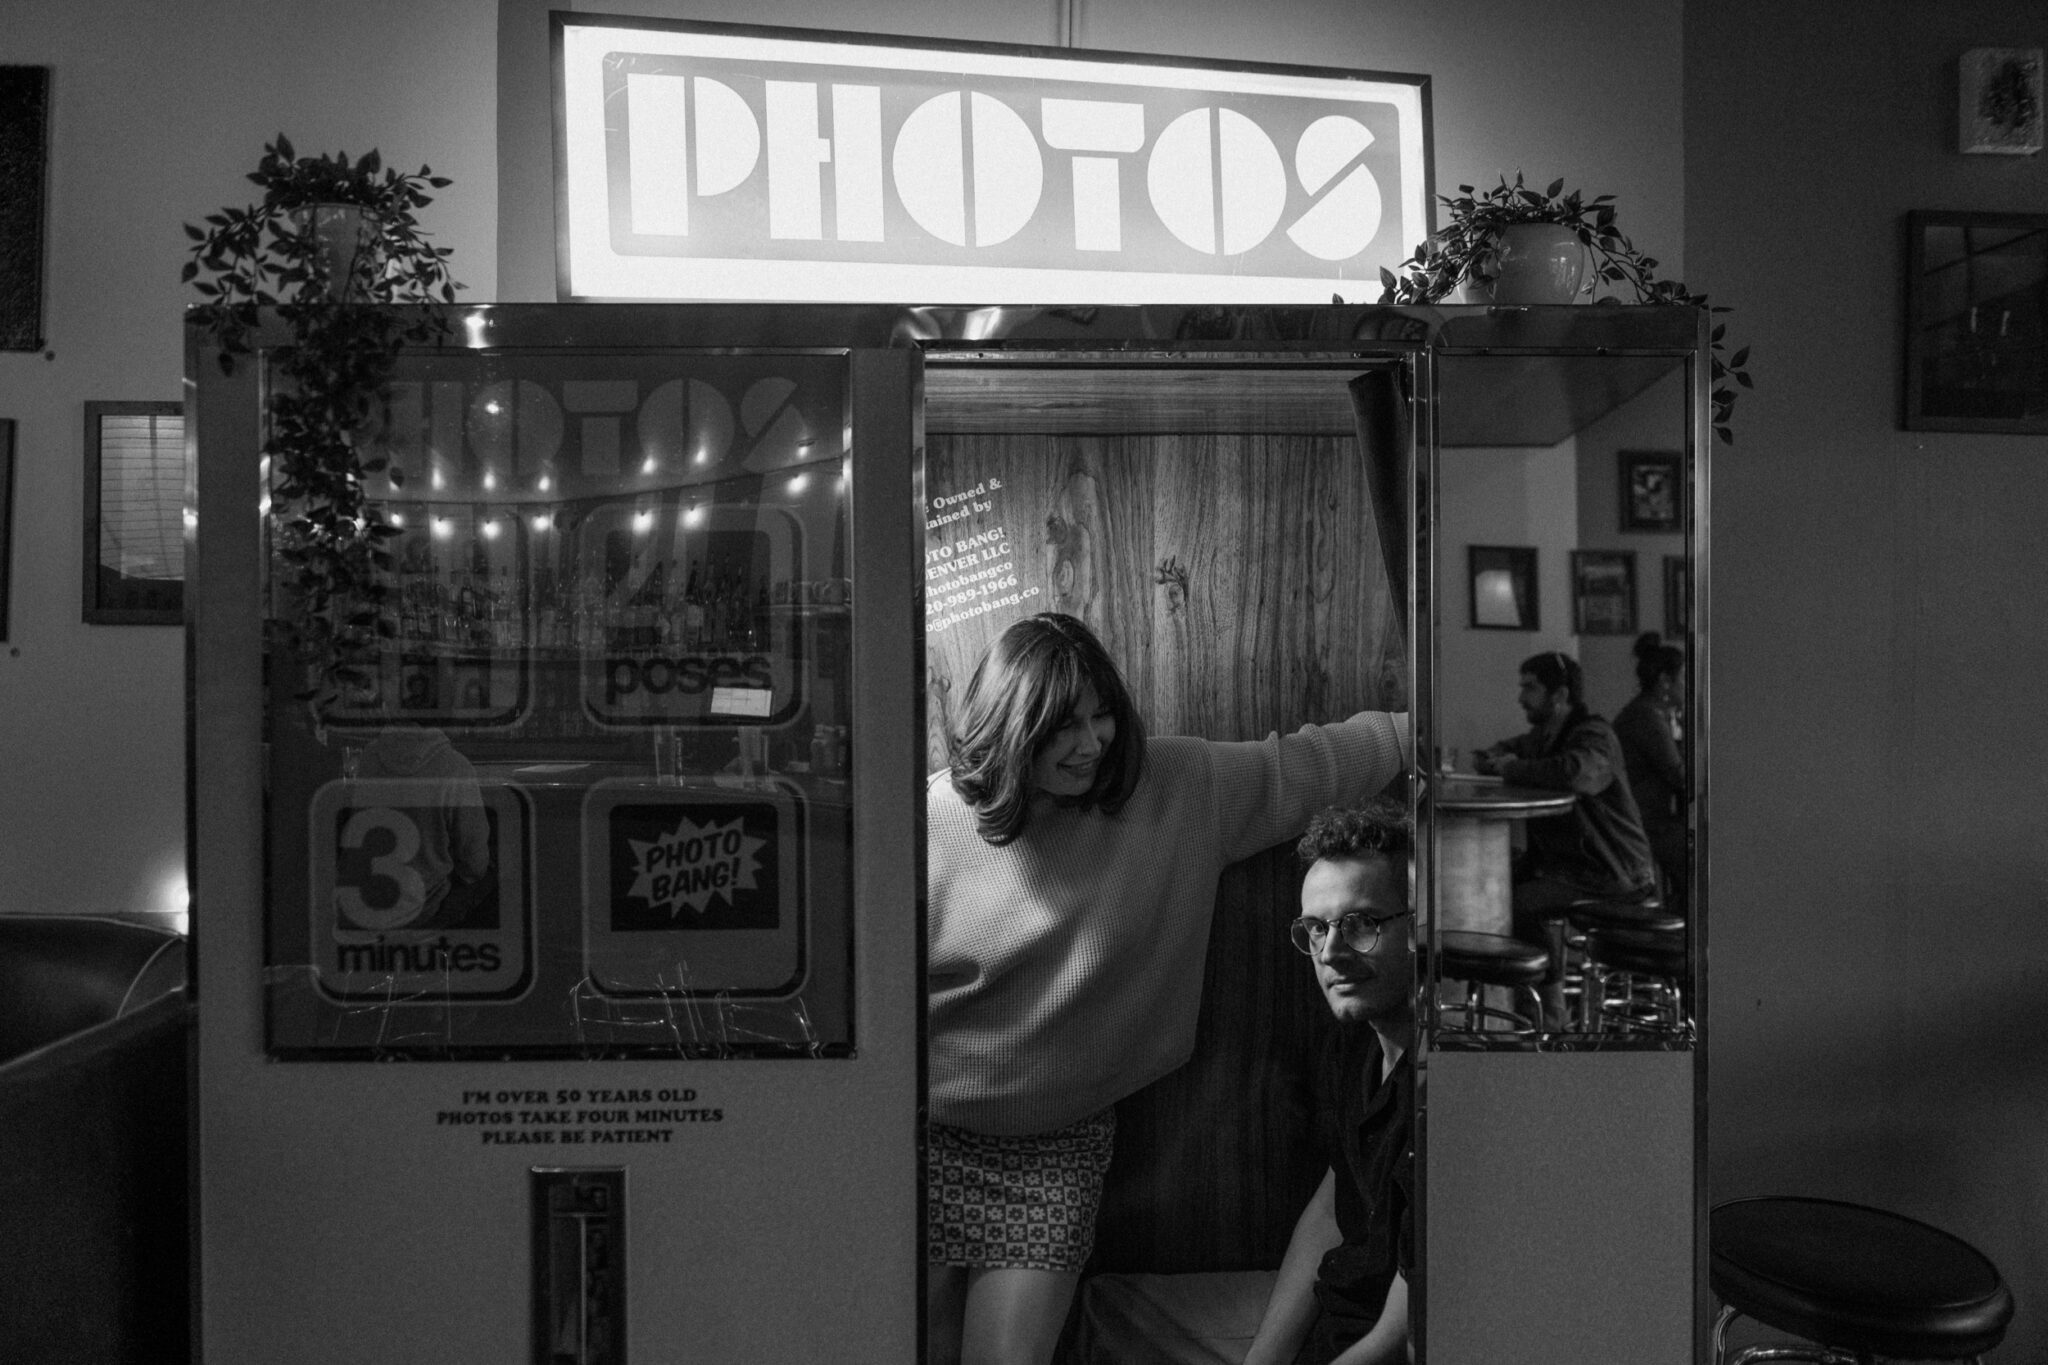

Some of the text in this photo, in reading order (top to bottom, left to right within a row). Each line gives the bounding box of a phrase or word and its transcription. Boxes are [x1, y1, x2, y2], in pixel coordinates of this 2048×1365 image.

[627, 72, 1383, 261] PHOTOS
[933, 482, 986, 510] Owned
[988, 477, 1003, 491] &
[973, 500, 992, 513] by
[955, 526, 1006, 554] BANG!
[925, 542, 1011, 581] ENVER LLC
[605, 656, 773, 706] poses
[333, 806, 427, 931] 3
[646, 827, 742, 874] PHOTO
[651, 856, 741, 902] BANG!
[336, 933, 502, 973] minutes
[462, 1087, 698, 1105] I'M OVER 50 YEARS OLD
[436, 1107, 725, 1126] PHOTOS TAKE FOUR MINUTES
[481, 1128, 674, 1145] PLEASE BE PATIENT
